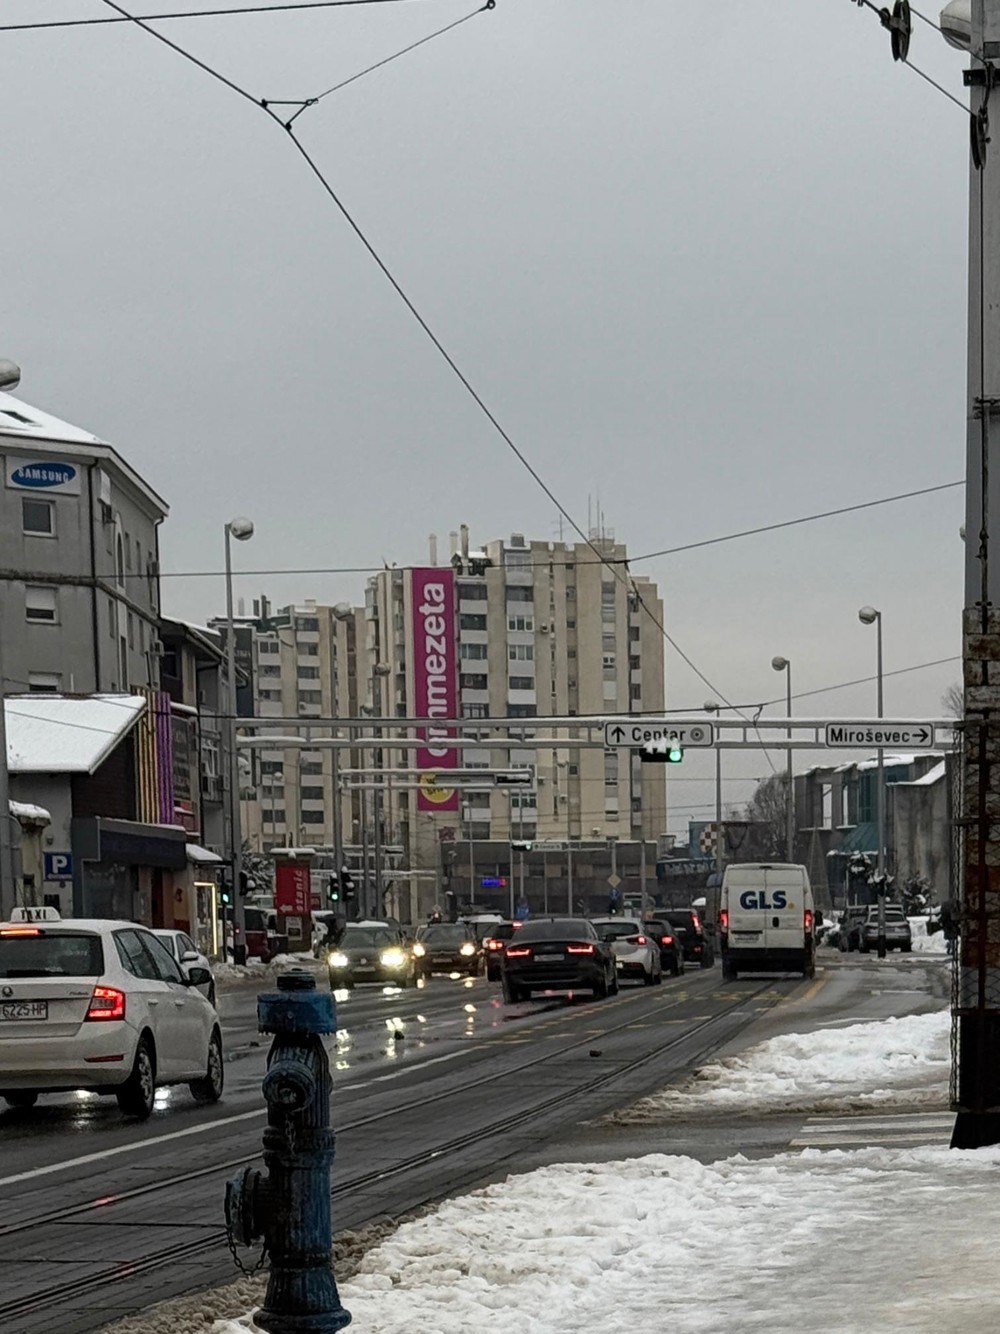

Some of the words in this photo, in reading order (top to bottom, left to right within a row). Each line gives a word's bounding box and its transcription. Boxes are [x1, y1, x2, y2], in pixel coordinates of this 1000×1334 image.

[18, 467, 69, 484] SAMSUNG
[632, 727, 686, 741] Centar
[830, 727, 910, 742] Miroševec
[52, 855, 68, 874] P
[21, 909, 47, 920] TAXI
